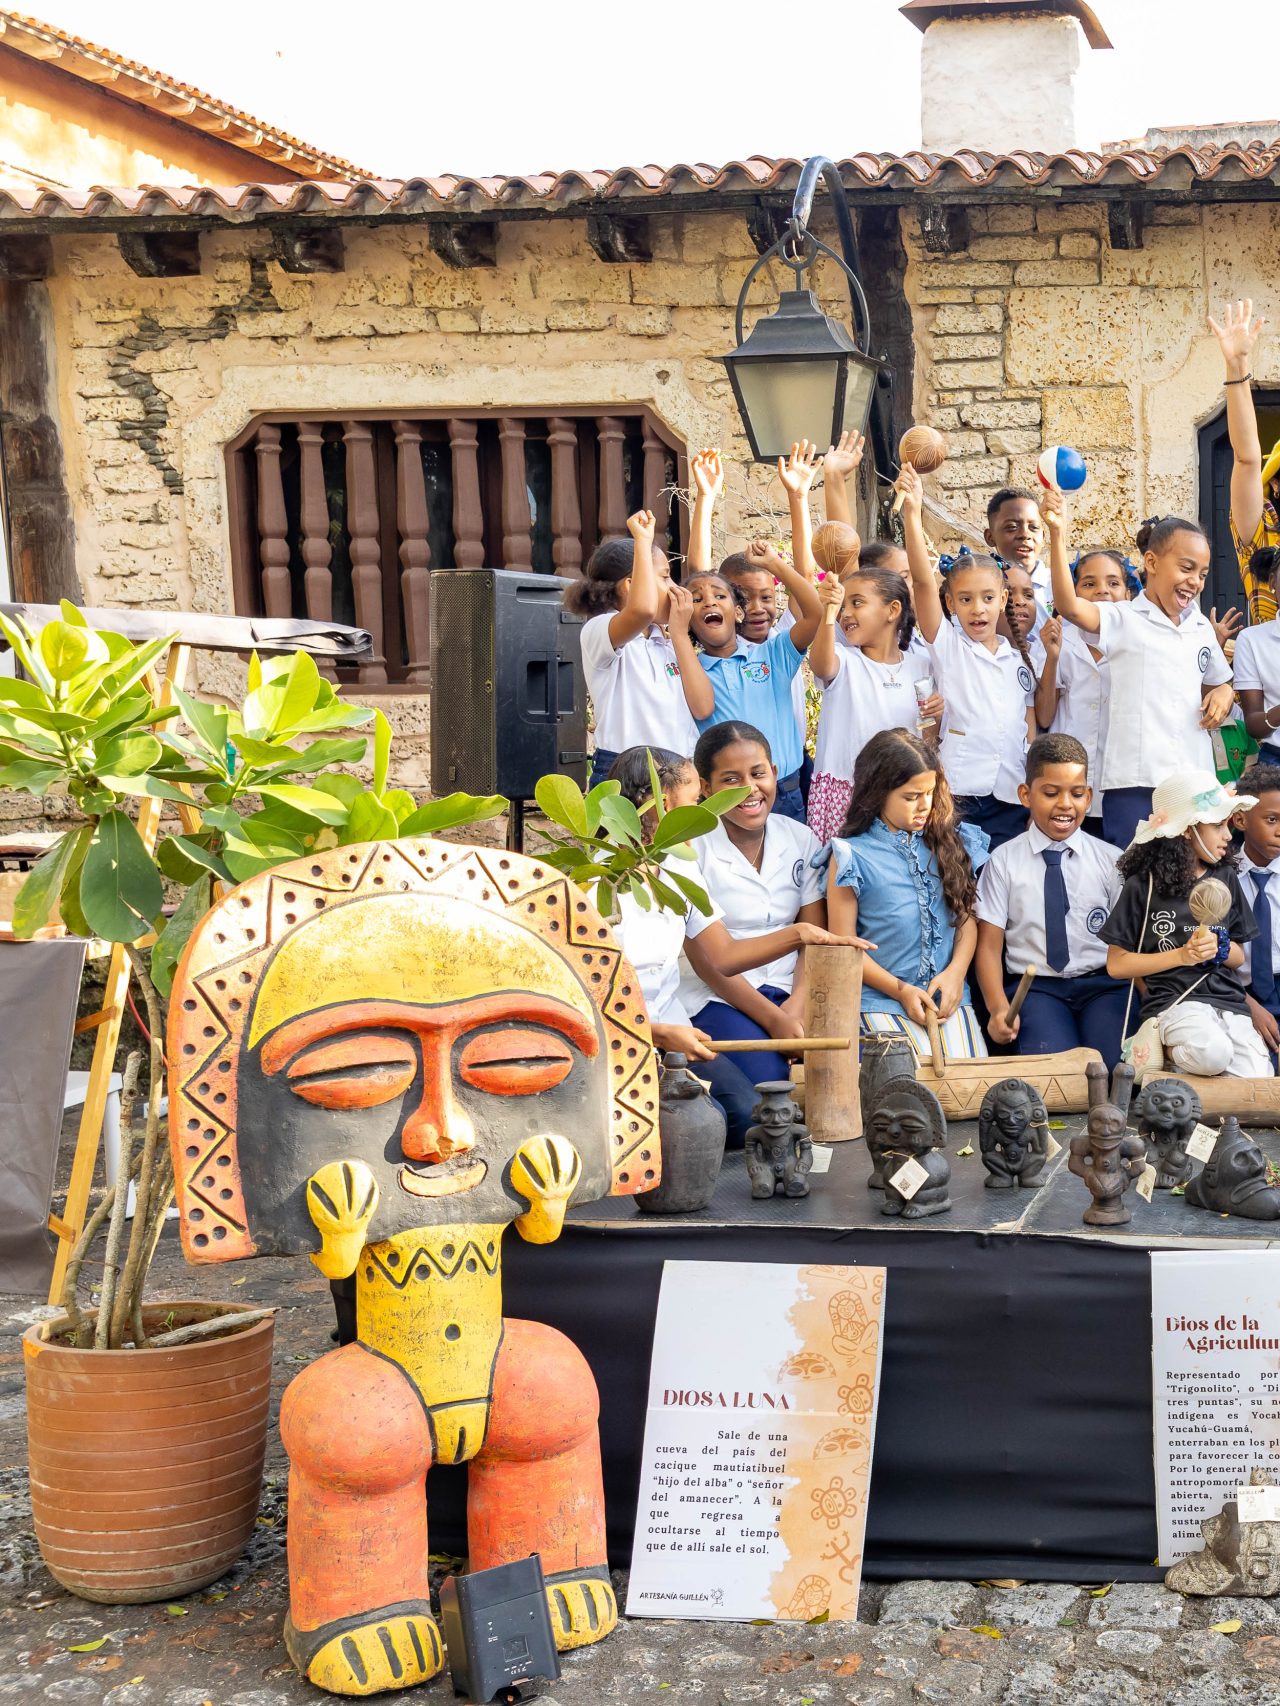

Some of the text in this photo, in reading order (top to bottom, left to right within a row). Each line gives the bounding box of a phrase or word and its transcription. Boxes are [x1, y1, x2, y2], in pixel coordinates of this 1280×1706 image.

[1167, 1315, 1259, 1331] Dios de la
[1166, 1370, 1241, 1382] Representado
[1260, 1372, 1279, 1381] por
[664, 1390, 789, 1409] DIOSA LUNA
[1167, 1399, 1189, 1407] tres
[717, 1430, 788, 1442] Sale de una
[1168, 1438, 1229, 1447] enterraban
[1249, 1438, 1265, 1447] los
[655, 1445, 787, 1459] cueva del país del
[1169, 1453, 1193, 1462] para
[1197, 1451, 1250, 1460] favorecer
[1253, 1451, 1264, 1460] la
[654, 1460, 697, 1473] cacique
[1169, 1465, 1189, 1473] Por
[1192, 1464, 1202, 1473] lo
[1206, 1464, 1247, 1475] general
[683, 1476, 701, 1487] del
[1170, 1478, 1244, 1488] antropomorfa
[651, 1491, 668, 1502] del
[753, 1495, 761, 1505] A
[772, 1496, 783, 1506] la
[1170, 1491, 1213, 1500] abierta,
[1171, 1504, 1206, 1513] avidez
[649, 1510, 781, 1523] que regresa a
[647, 1524, 780, 1541] ocultarse al tiempo
[646, 1541, 769, 1555] que de allí sale el sol.
